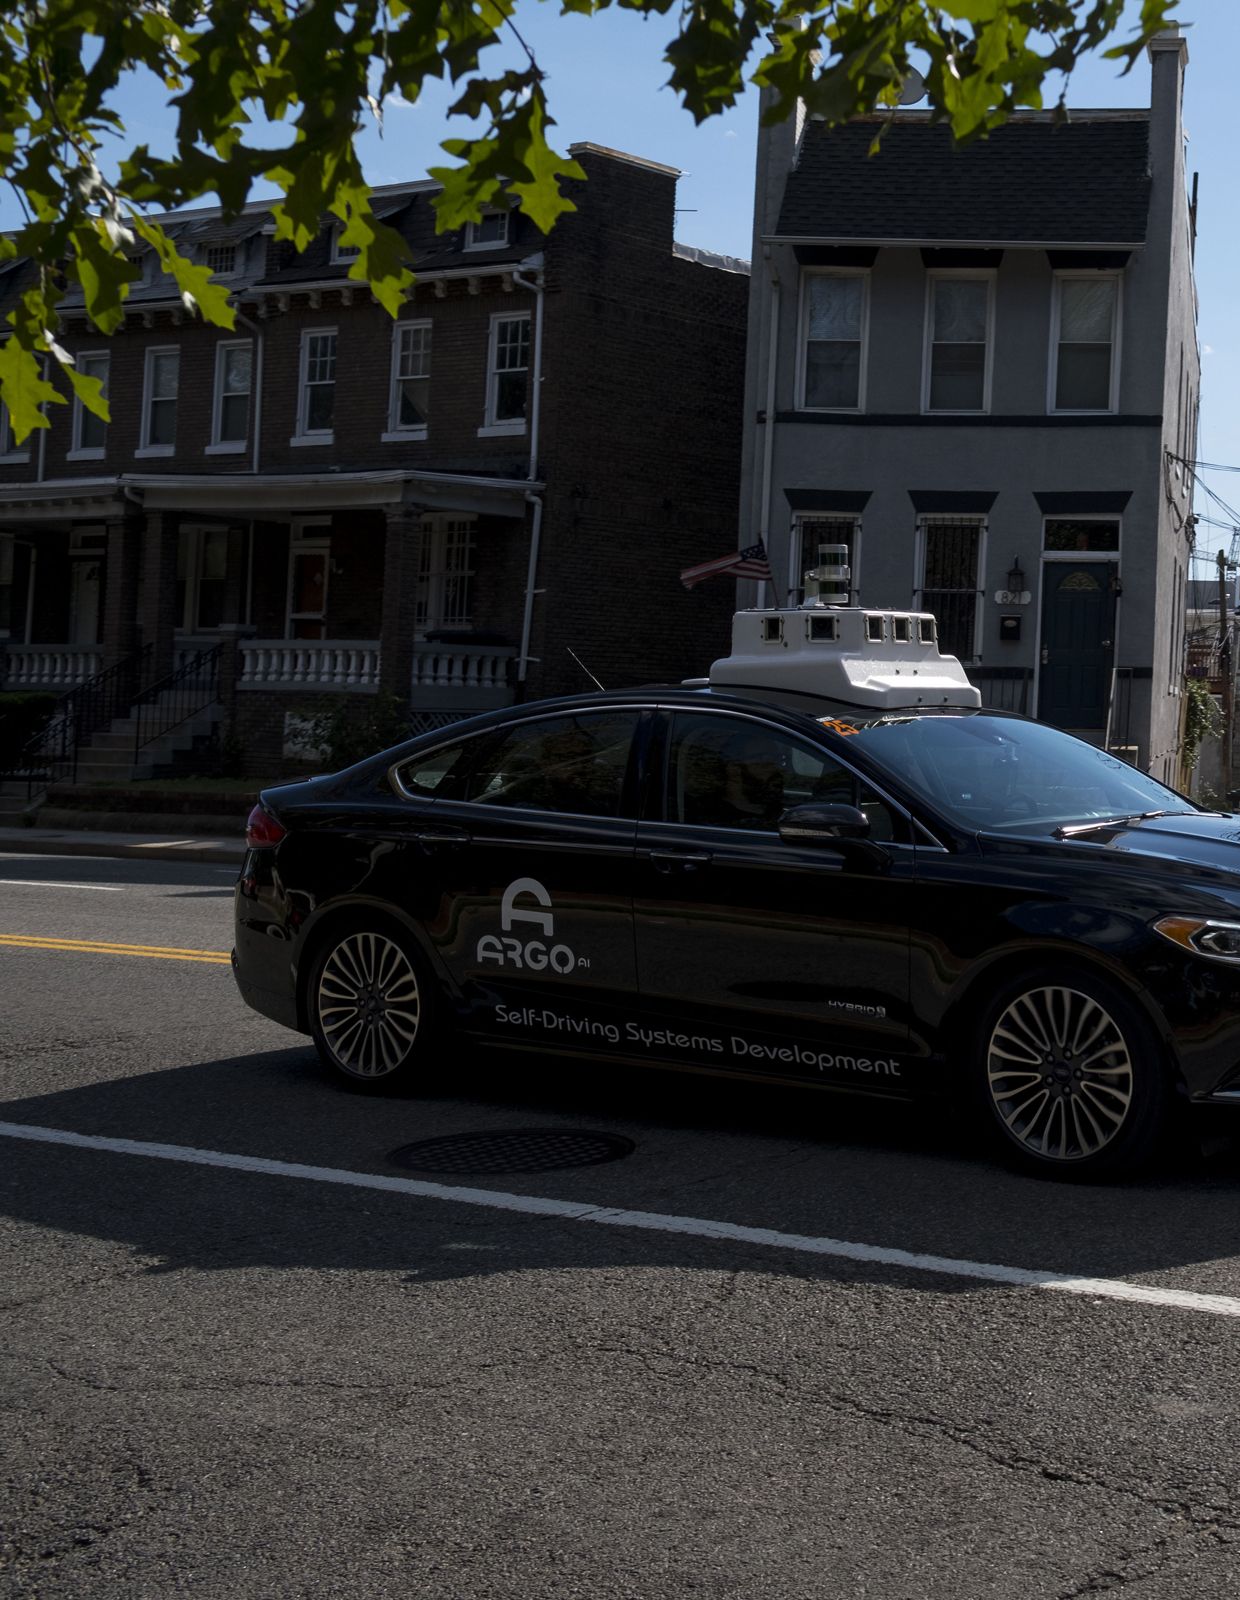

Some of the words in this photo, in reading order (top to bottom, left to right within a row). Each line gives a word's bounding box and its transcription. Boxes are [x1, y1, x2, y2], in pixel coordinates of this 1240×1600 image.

[476, 934, 576, 974] ARGO
[577, 956, 591, 968] AI
[495, 1004, 621, 1043] Self-Driving
[625, 1022, 725, 1053] Systems
[731, 1036, 902, 1077] Development
